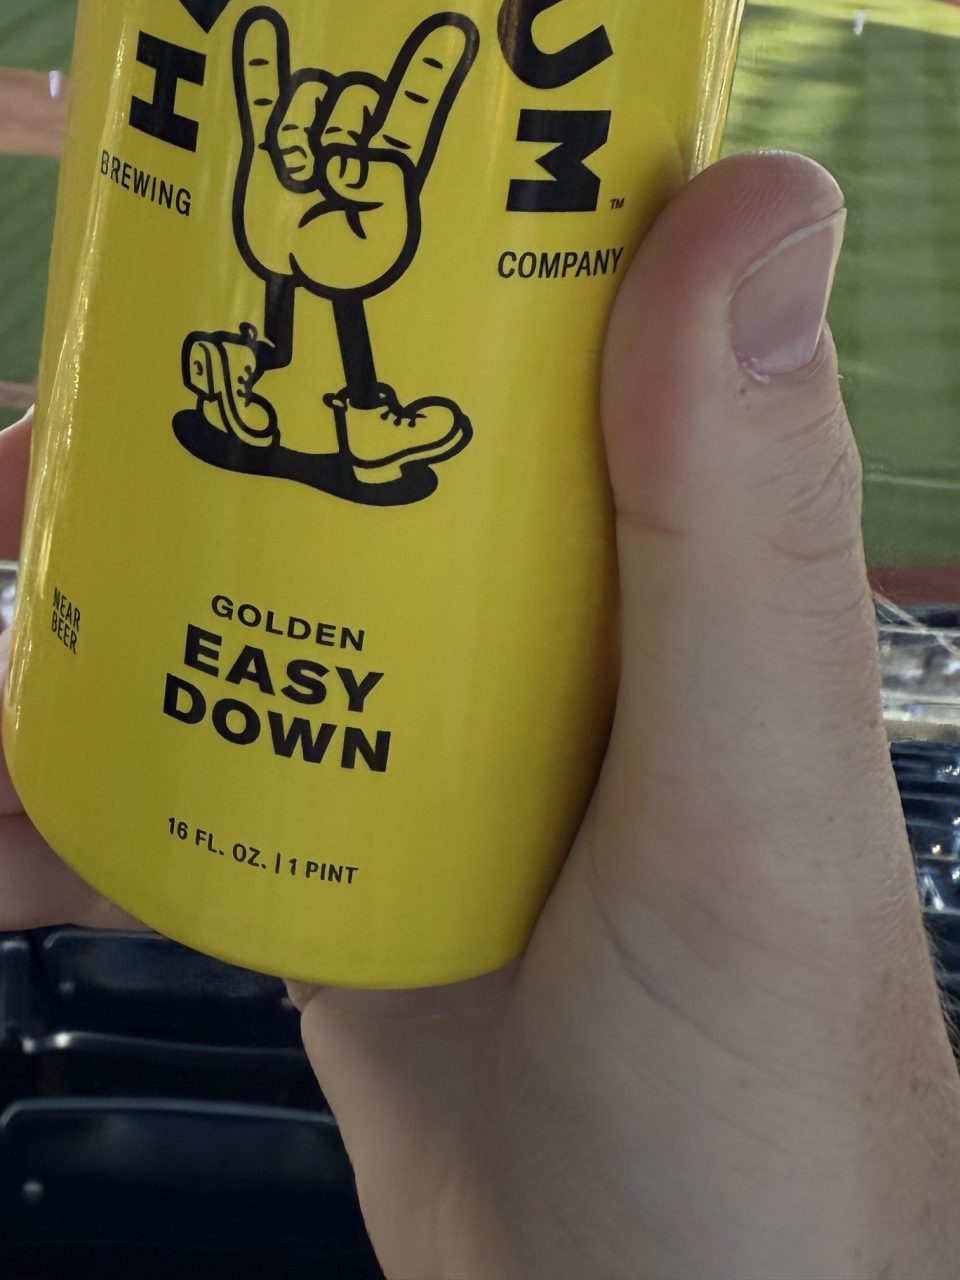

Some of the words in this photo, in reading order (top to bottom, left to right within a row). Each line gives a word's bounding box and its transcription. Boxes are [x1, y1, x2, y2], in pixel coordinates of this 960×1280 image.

[101, 149, 192, 217] BREWING
[498, 247, 625, 278] COMPANY
[52, 610, 77, 655] BEER
[53, 587, 81, 632] NEAR
[211, 595, 365, 651] GOLDEN
[184, 623, 384, 713] EASY
[163, 672, 391, 772] DOWN
[169, 817, 188, 840] 16
[195, 829, 224, 856] FL.
[232, 843, 267, 869] OZ.
[289, 858, 298, 875] 1
[305, 860, 359, 884] PINT
